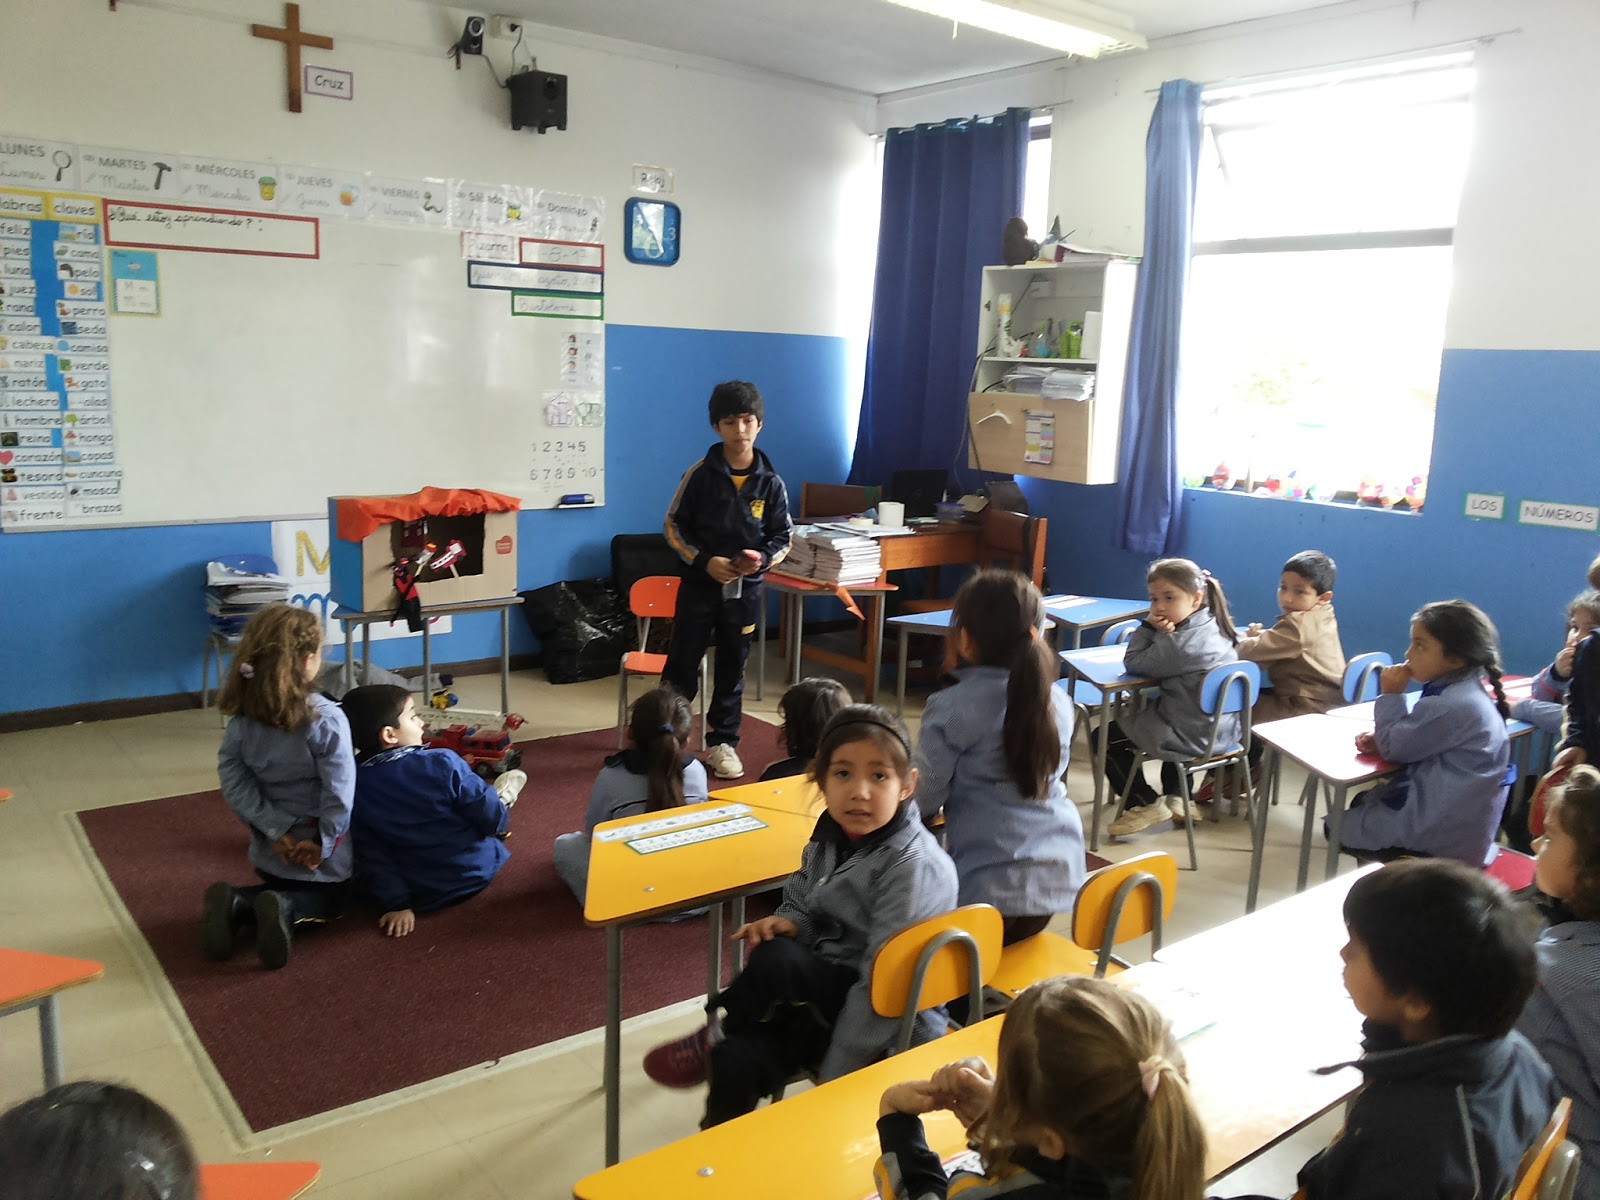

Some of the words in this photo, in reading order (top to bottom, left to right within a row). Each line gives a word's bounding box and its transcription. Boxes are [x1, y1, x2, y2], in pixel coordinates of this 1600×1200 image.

[314, 74, 344, 90] Cruz
[0, 142, 45, 157] LUNES
[98, 157, 146, 171] MARTES
[194, 163, 256, 180] MIÉRCOLES
[296, 175, 333, 188] JUEVES
[381, 187, 420, 200] VIERNES
[54, 200, 96, 217] claves
[547, 202, 588, 217] Domingo
[0, 222, 30, 236] feliz
[77, 228, 94, 240] río
[3, 244, 30, 257] pies
[4, 263, 31, 275] luna
[75, 266, 99, 279] pelo
[80, 286, 96, 296] sol
[6, 303, 34, 314] rana
[73, 307, 106, 318] perro
[77, 324, 106, 334] seda
[12, 340, 54, 350] cabeza
[71, 343, 108, 353] camisa
[14, 359, 44, 368] nariz
[74, 360, 109, 370] verde
[12, 376, 48, 387] ratón
[80, 380, 107, 391] gato
[12, 396, 59, 407] lechero
[83, 396, 108, 406] alas
[80, 414, 111, 425] árbol
[19, 433, 51, 443] reino
[79, 432, 113, 446] hongo
[543, 441, 551, 452] 2
[556, 441, 564, 452] 3
[567, 442, 576, 450] 4
[578, 441, 587, 452] 5
[15, 451, 62, 462] corazón
[20, 472, 63, 482] tesoro
[530, 469, 538, 480] 6
[543, 469, 551, 480] 7
[555, 468, 563, 479] 8
[567, 467, 576, 479] 9
[23, 490, 64, 500] vestido
[82, 504, 122, 514] brazos
[1472, 500, 1498, 512] LOS
[1525, 504, 1594, 523] NÚMEROS
[19, 509, 64, 521] frente
[295, 530, 329, 577] M
